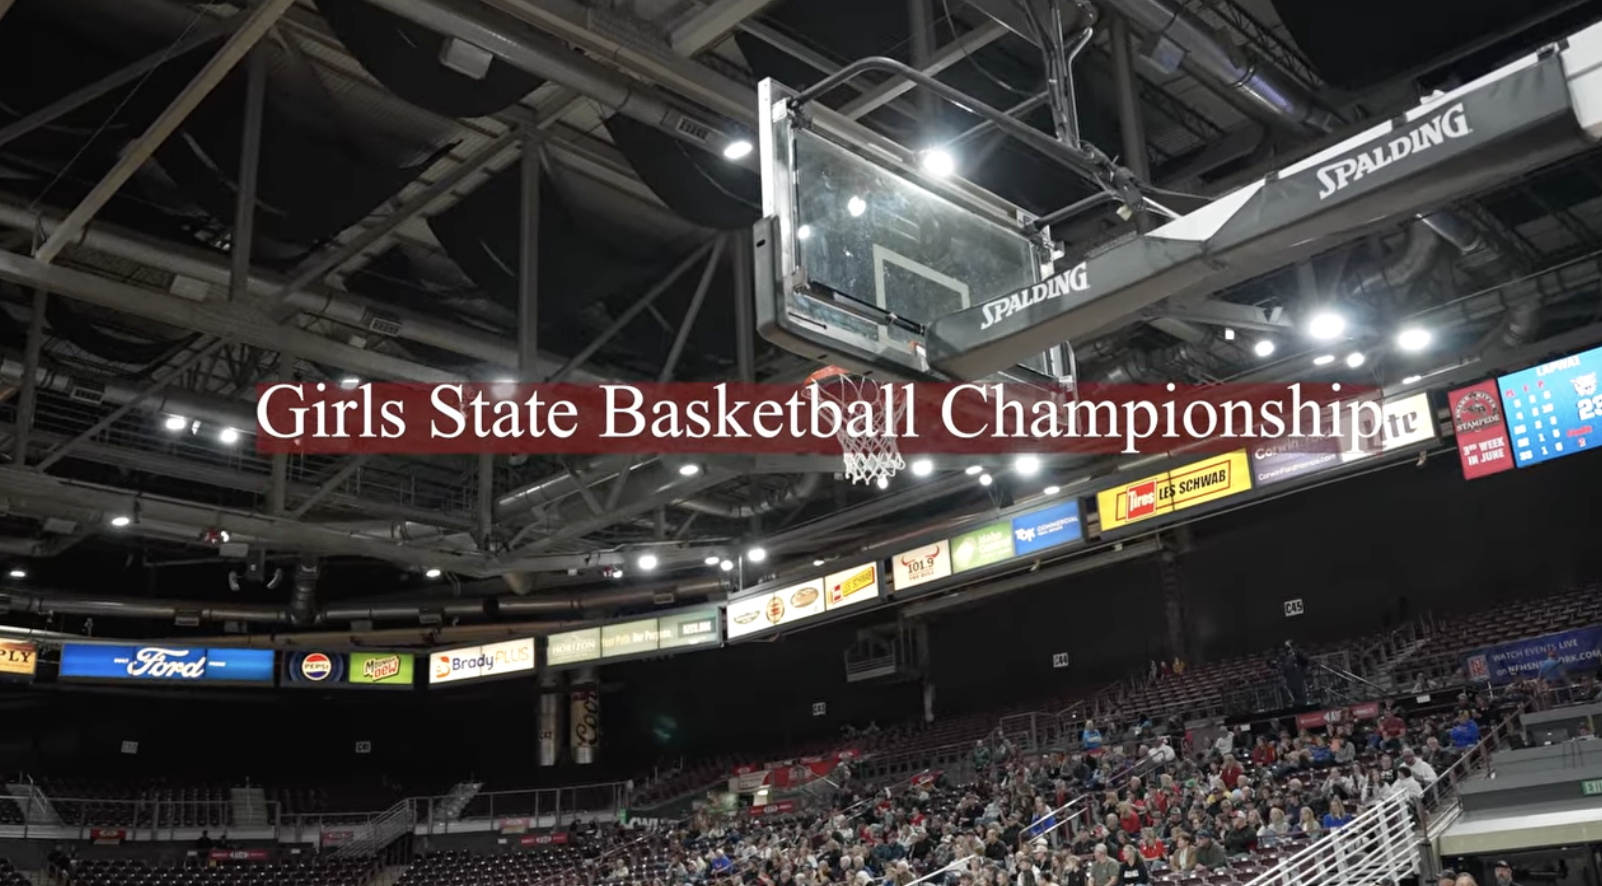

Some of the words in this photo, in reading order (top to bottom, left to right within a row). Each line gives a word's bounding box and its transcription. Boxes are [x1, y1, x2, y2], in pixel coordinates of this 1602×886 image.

[1317, 103, 1468, 200] SPALDING
[981, 262, 1090, 328] SPALDING
[1456, 414, 1501, 432] STAMPEDE
[1479, 437, 1505, 452] WEEK
[1468, 455, 1478, 466] IN
[1481, 449, 1505, 463] JUNE
[1128, 490, 1155, 512] Tires
[1159, 485, 1176, 500] LES
[1179, 470, 1226, 494] SCHWAB
[908, 557, 934, 574] 101.9
[1286, 601, 1303, 614] C45
[552, 640, 596, 654] HORIZON
[1492, 649, 1523, 662] WATCH
[1524, 643, 1556, 657] EVENTS
[1559, 639, 1579, 649] LIVE
[128, 648, 207, 678] Ford
[304, 662, 329, 670] PEPSI
[1508, 650, 1602, 675] NFHSNORK.COM
